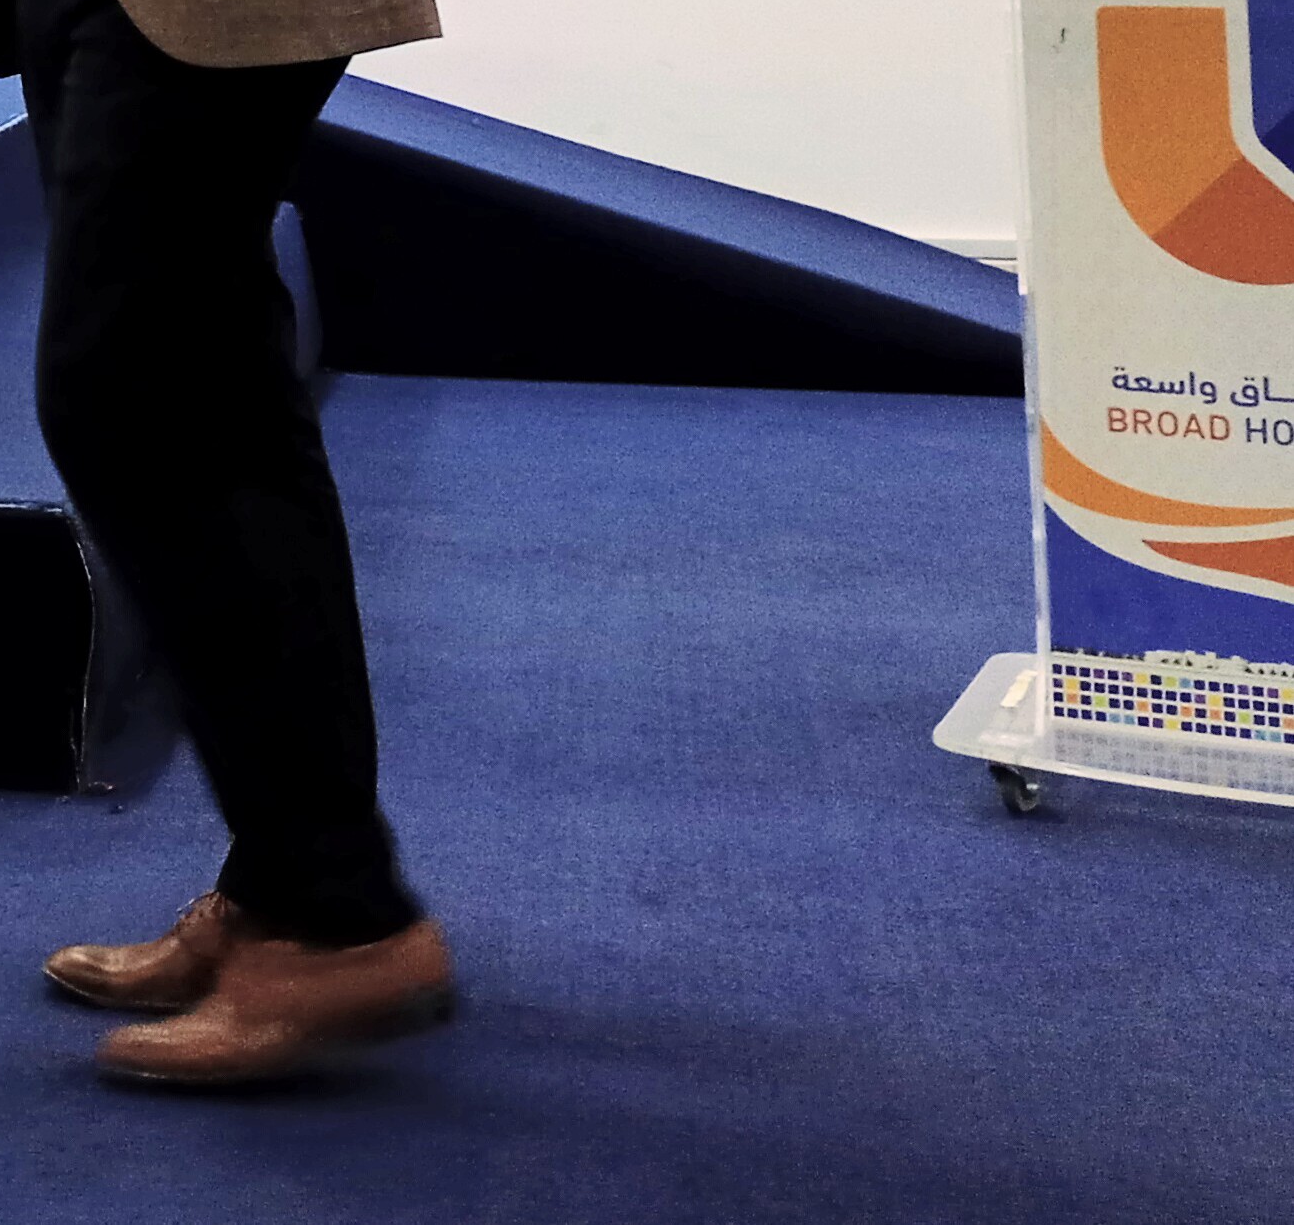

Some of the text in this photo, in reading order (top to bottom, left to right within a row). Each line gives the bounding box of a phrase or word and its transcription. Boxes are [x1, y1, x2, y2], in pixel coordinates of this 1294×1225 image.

[1112, 366, 1217, 404] واسعة
[1108, 406, 1294, 446] BROAD HO
